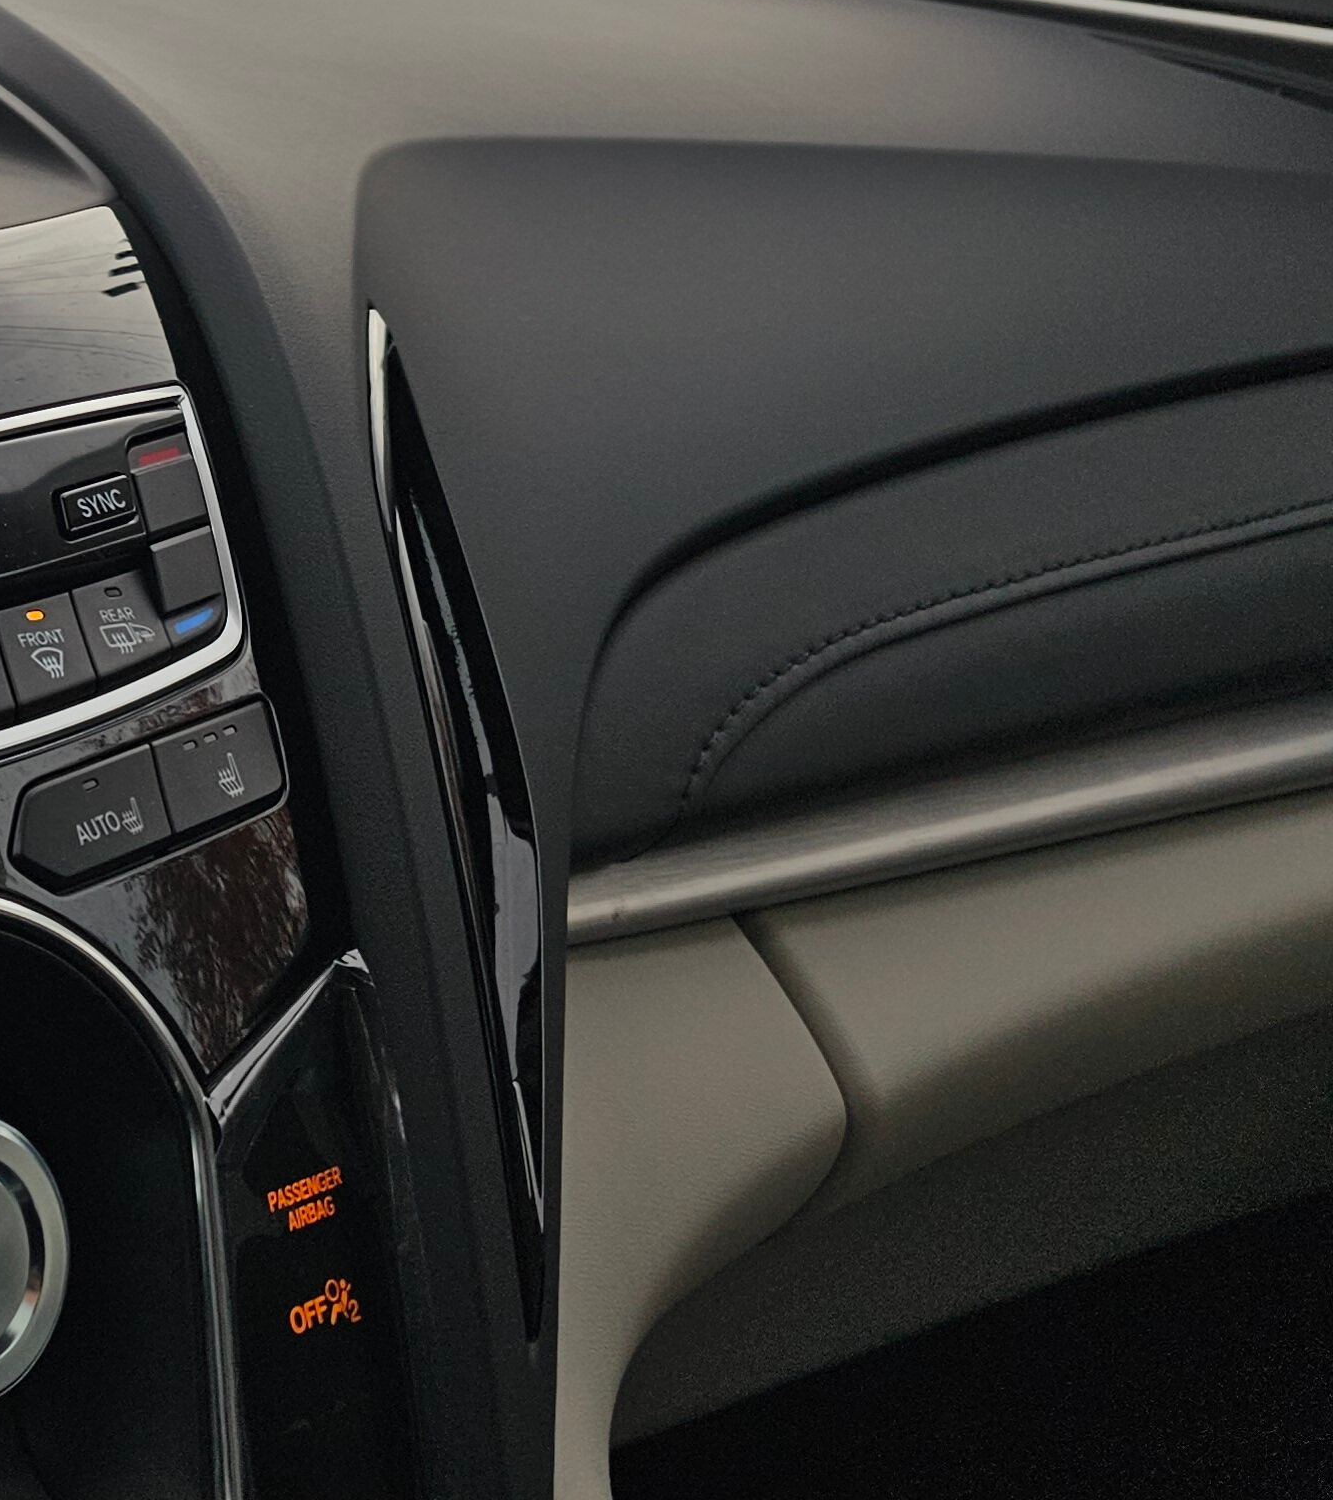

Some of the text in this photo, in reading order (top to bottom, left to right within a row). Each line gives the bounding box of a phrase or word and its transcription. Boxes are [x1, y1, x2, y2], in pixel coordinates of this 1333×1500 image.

[77, 488, 126, 518] SYNC
[99, 607, 136, 623] REAR
[18, 628, 65, 648] FRONT
[75, 810, 120, 846] AUTO
[267, 1165, 343, 1213] PASSENGER
[288, 1196, 335, 1232] AIRBAG
[289, 1295, 328, 1334] OFF
